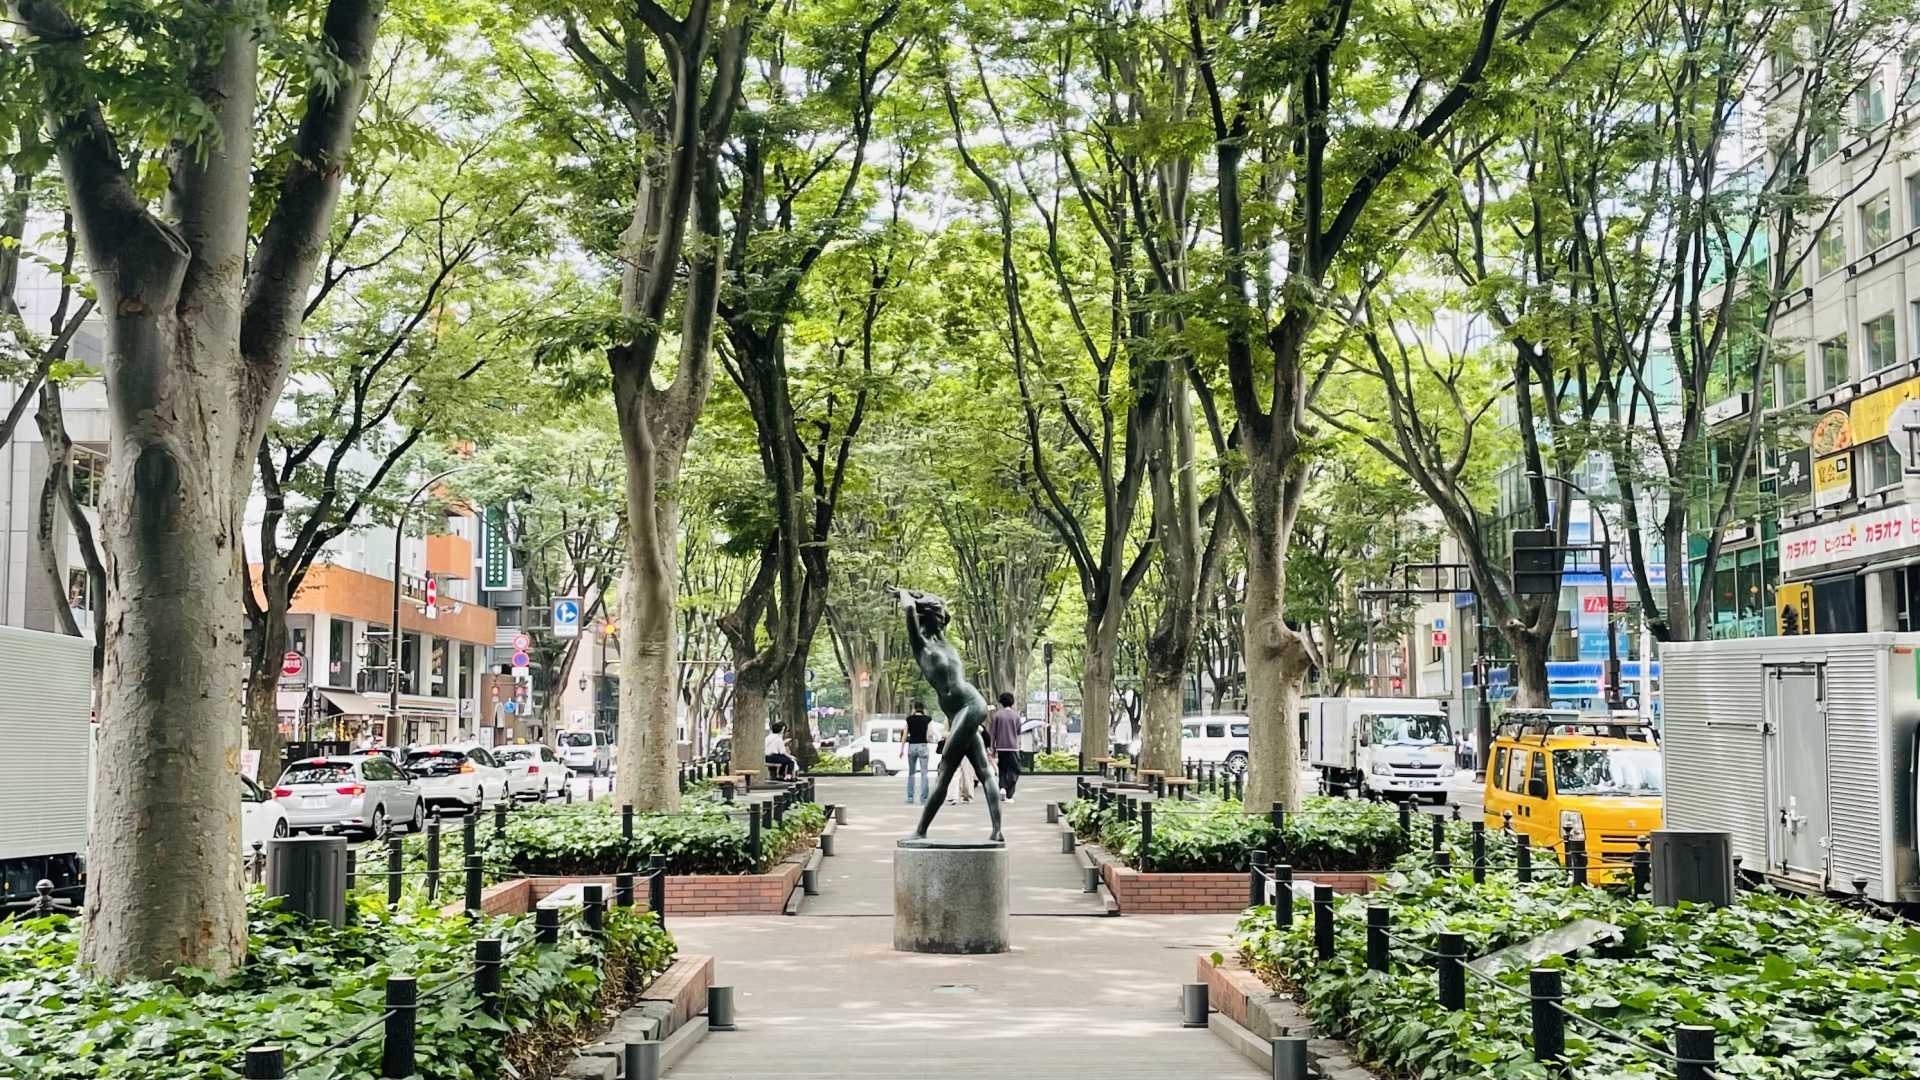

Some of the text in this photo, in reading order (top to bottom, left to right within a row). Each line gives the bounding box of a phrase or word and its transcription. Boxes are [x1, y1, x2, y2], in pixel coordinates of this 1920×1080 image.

[1817, 463, 1836, 485] 宴会
[1786, 540, 1817, 560] カラオケ
[1865, 519, 1902, 543] カラオケ
[241, 752, 253, 773] 出口
